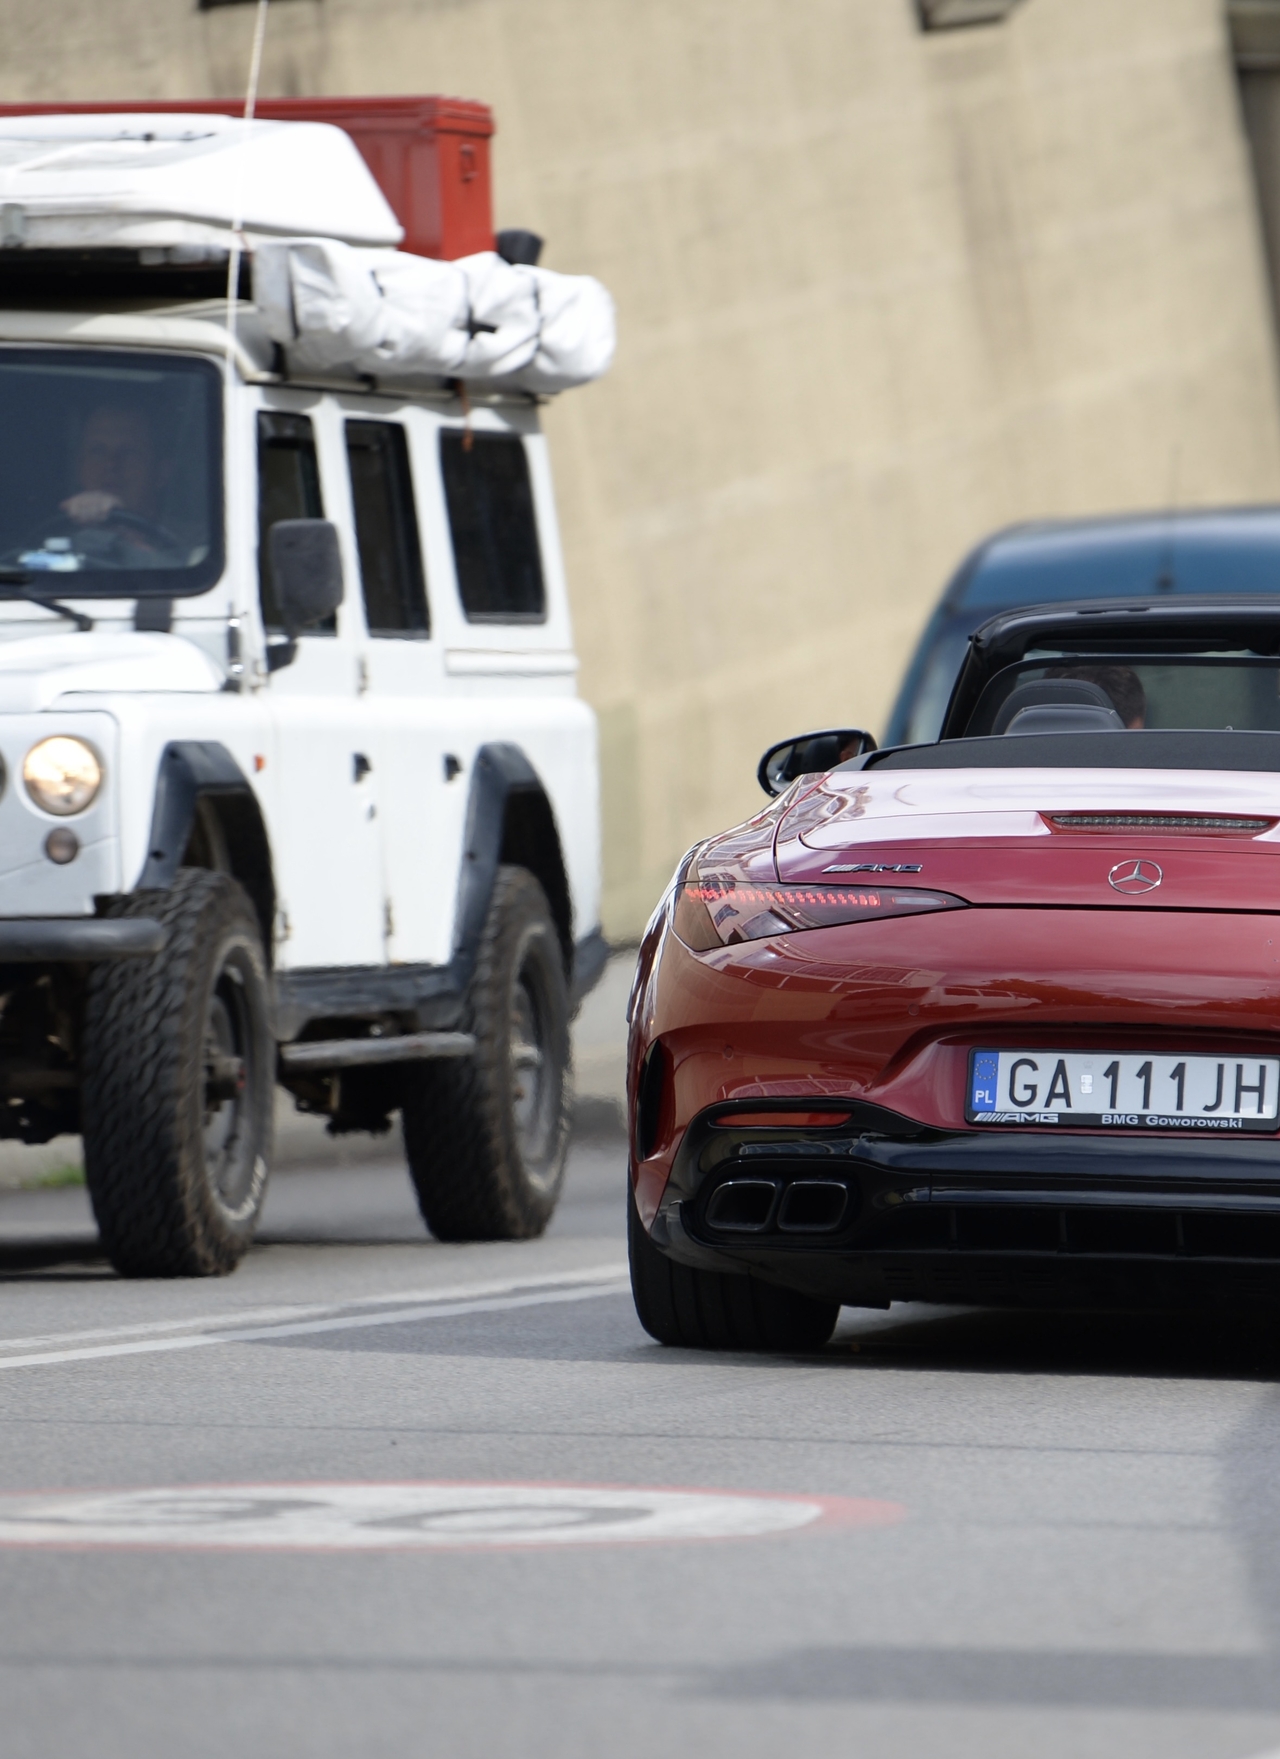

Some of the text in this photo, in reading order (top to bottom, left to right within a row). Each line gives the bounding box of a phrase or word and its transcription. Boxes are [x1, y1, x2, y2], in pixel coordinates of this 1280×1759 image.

[852, 863, 923, 873] AMG
[1008, 1058, 1267, 1114] GA 111JH
[975, 1090, 993, 1104] PL
[1000, 1112, 1058, 1123] AMG
[1101, 1114, 1242, 1128] BMG Goworowski
